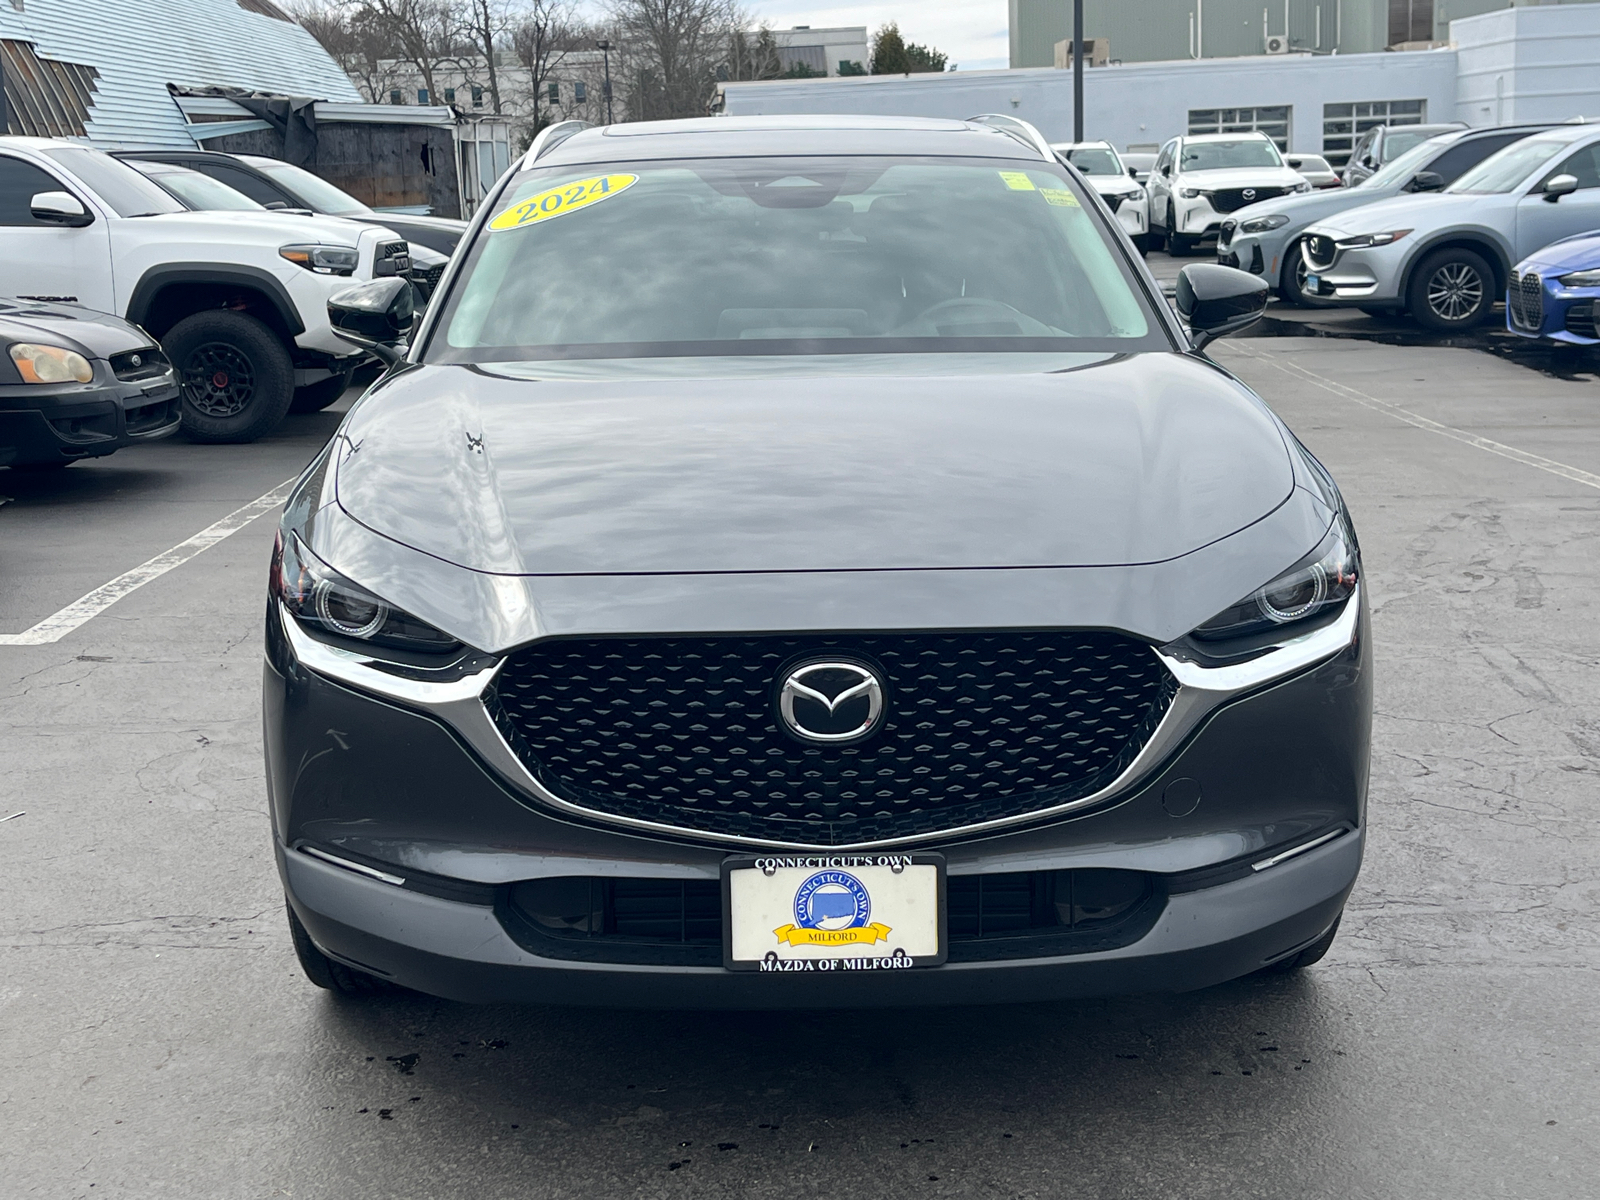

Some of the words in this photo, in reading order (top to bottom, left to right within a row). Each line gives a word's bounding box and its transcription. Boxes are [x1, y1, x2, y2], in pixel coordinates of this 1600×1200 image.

[516, 177, 614, 224] 2024
[754, 856, 873, 869] CONNECTICUT'S
[877, 855, 913, 866] OWN
[797, 873, 860, 922] CONNECTICUT'S
[856, 892, 868, 920] OWN
[808, 932, 857, 942] MILFORD
[759, 959, 814, 972] MAZDA
[818, 959, 839, 971] OF
[843, 957, 913, 970] MILFORD
